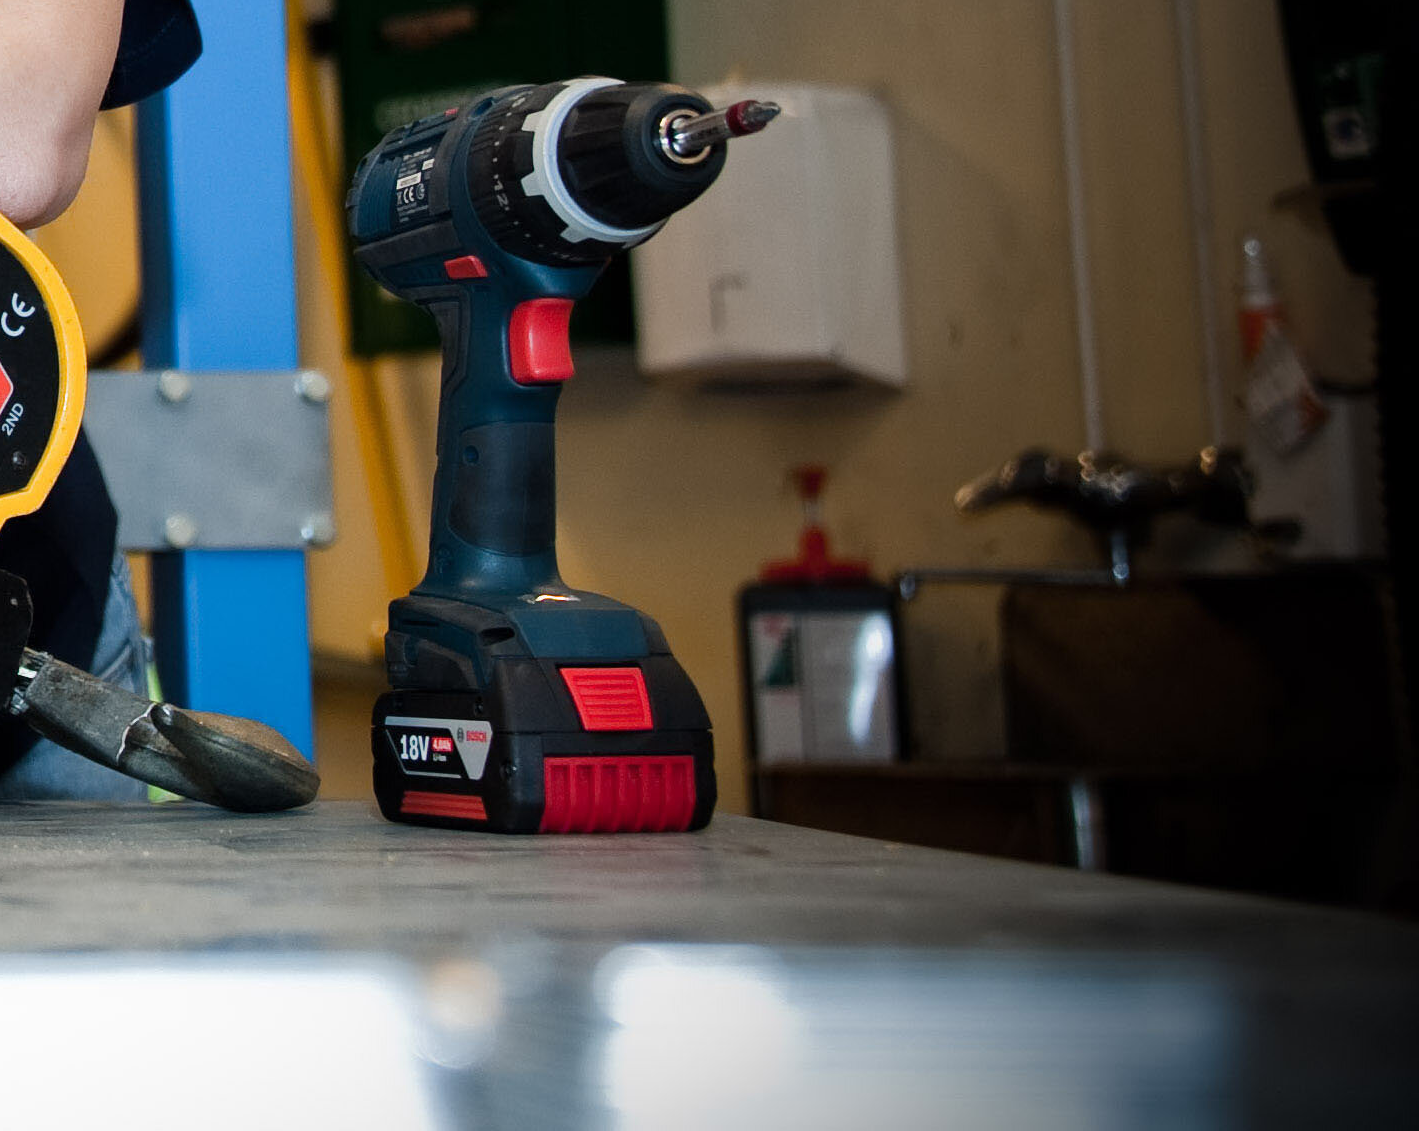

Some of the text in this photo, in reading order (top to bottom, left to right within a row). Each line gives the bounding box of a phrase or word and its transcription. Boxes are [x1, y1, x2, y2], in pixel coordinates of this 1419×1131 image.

[0, 292, 36, 337] CE
[1, 402, 24, 436] 2ND
[400, 734, 430, 761] 18V
